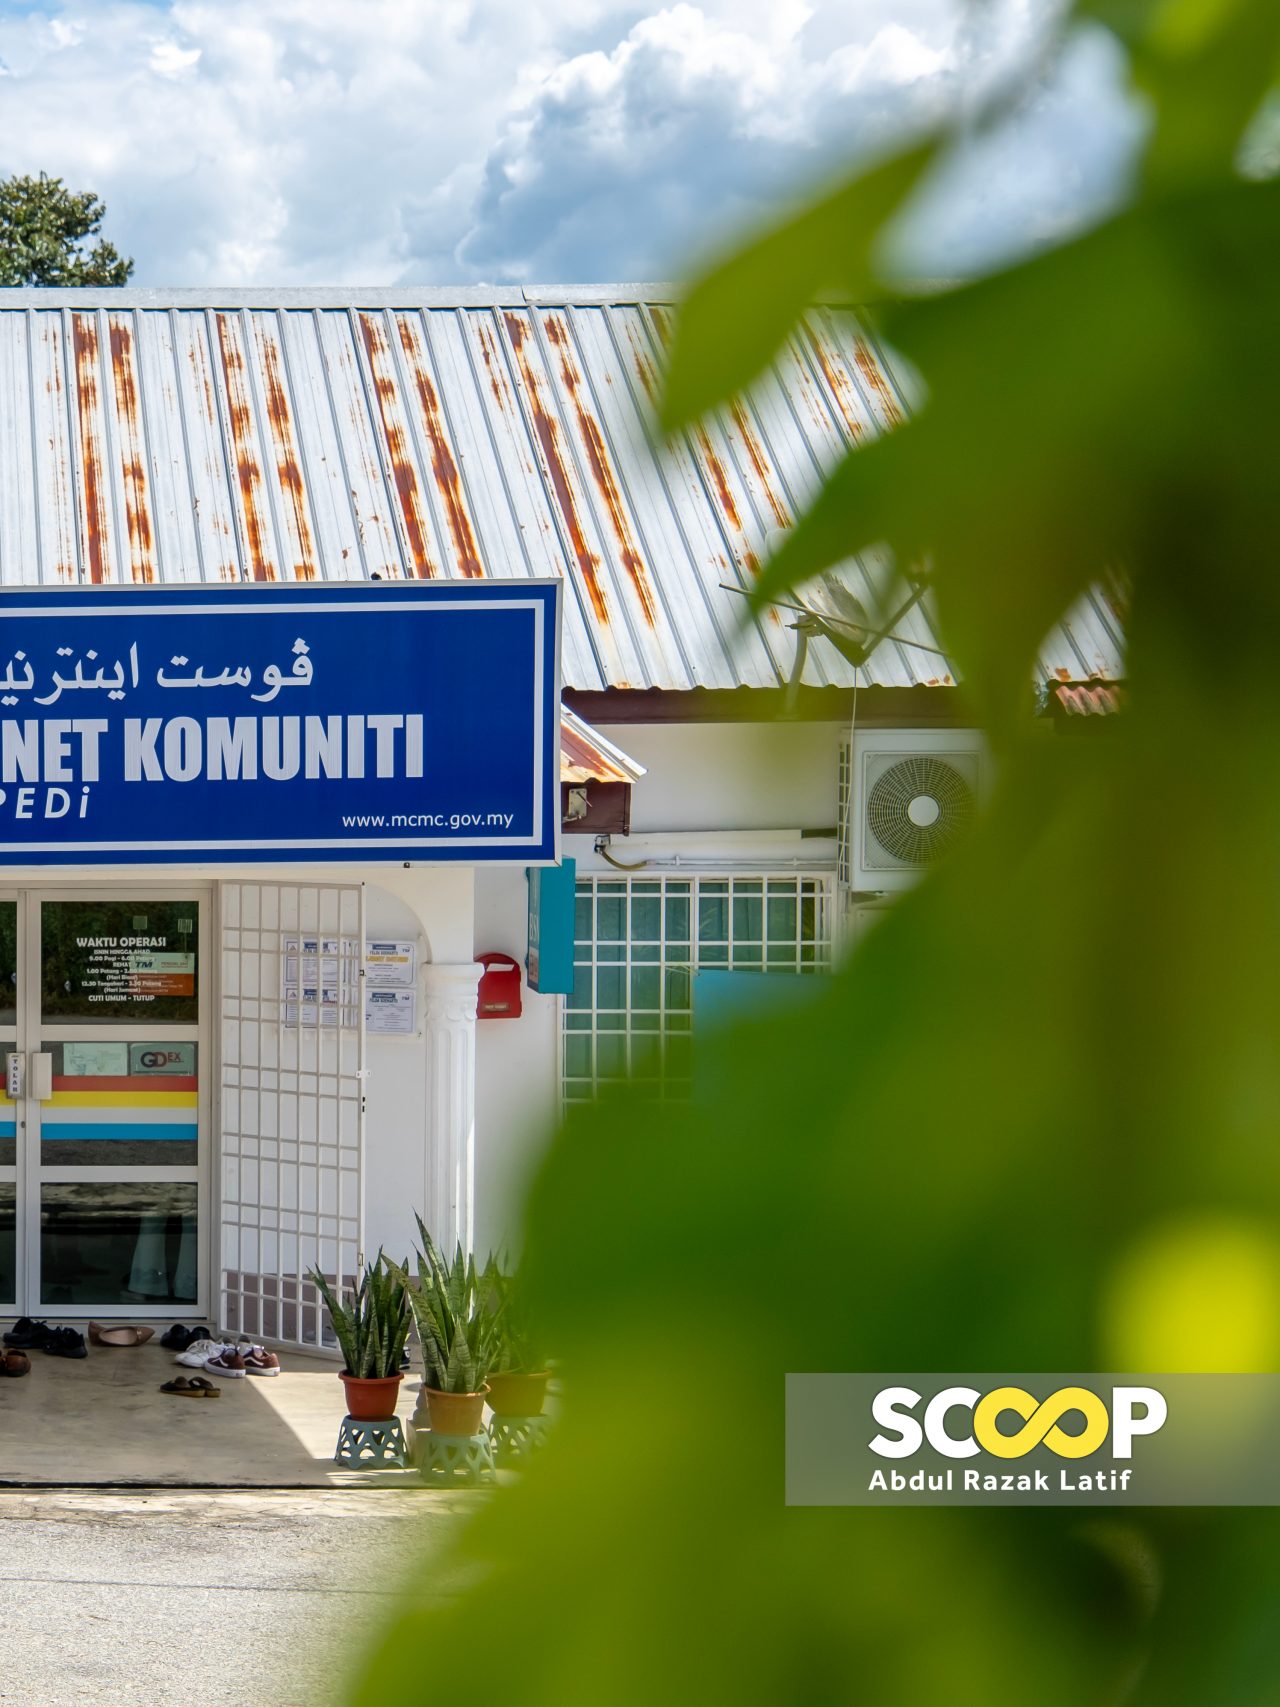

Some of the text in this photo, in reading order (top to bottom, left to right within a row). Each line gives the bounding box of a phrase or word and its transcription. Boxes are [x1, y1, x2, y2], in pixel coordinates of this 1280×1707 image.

[124, 714, 424, 782] KOMUNITI
[342, 813, 514, 830] www.mcmc.gov.my
[76, 937, 166, 947] WAKTU OPERASI
